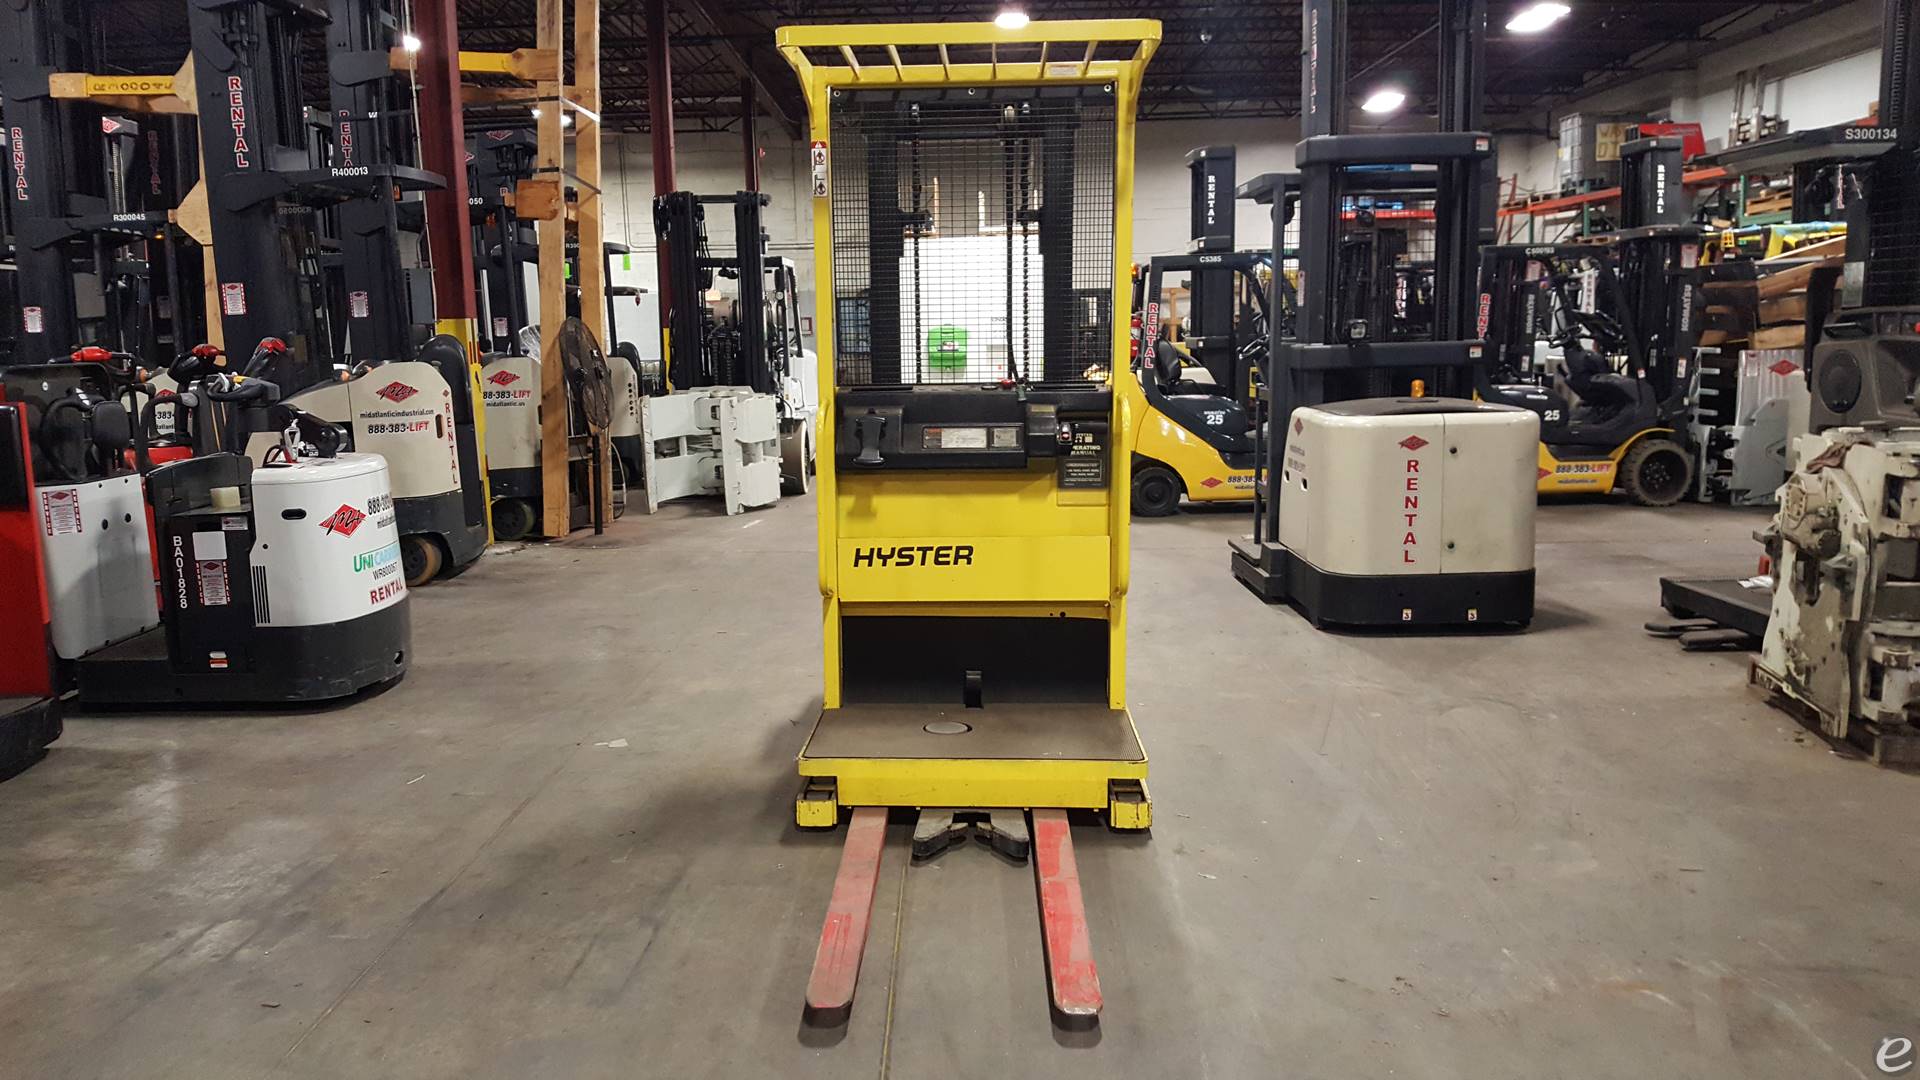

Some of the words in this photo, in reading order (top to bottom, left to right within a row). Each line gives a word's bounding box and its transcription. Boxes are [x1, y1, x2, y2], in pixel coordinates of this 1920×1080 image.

[228, 76, 249, 167] RENTAL
[1845, 128, 1897, 139] S300134
[11, 127, 28, 200] RENTAL
[332, 166, 368, 177] R400013
[1208, 175, 1216, 224] RENTAL
[1657, 164, 1665, 213] RENTAL
[113, 213, 146, 221] R300045
[1144, 303, 1159, 369] RENTAL
[1206, 415, 1224, 425] 25
[1544, 410, 1560, 421] 25
[444, 402, 458, 484] RENTAL
[1403, 460, 1419, 563] RENTAL
[173, 535, 188, 609] BA01828
[853, 545, 974, 568] HYSTER
[370, 577, 403, 605] RENTAL
